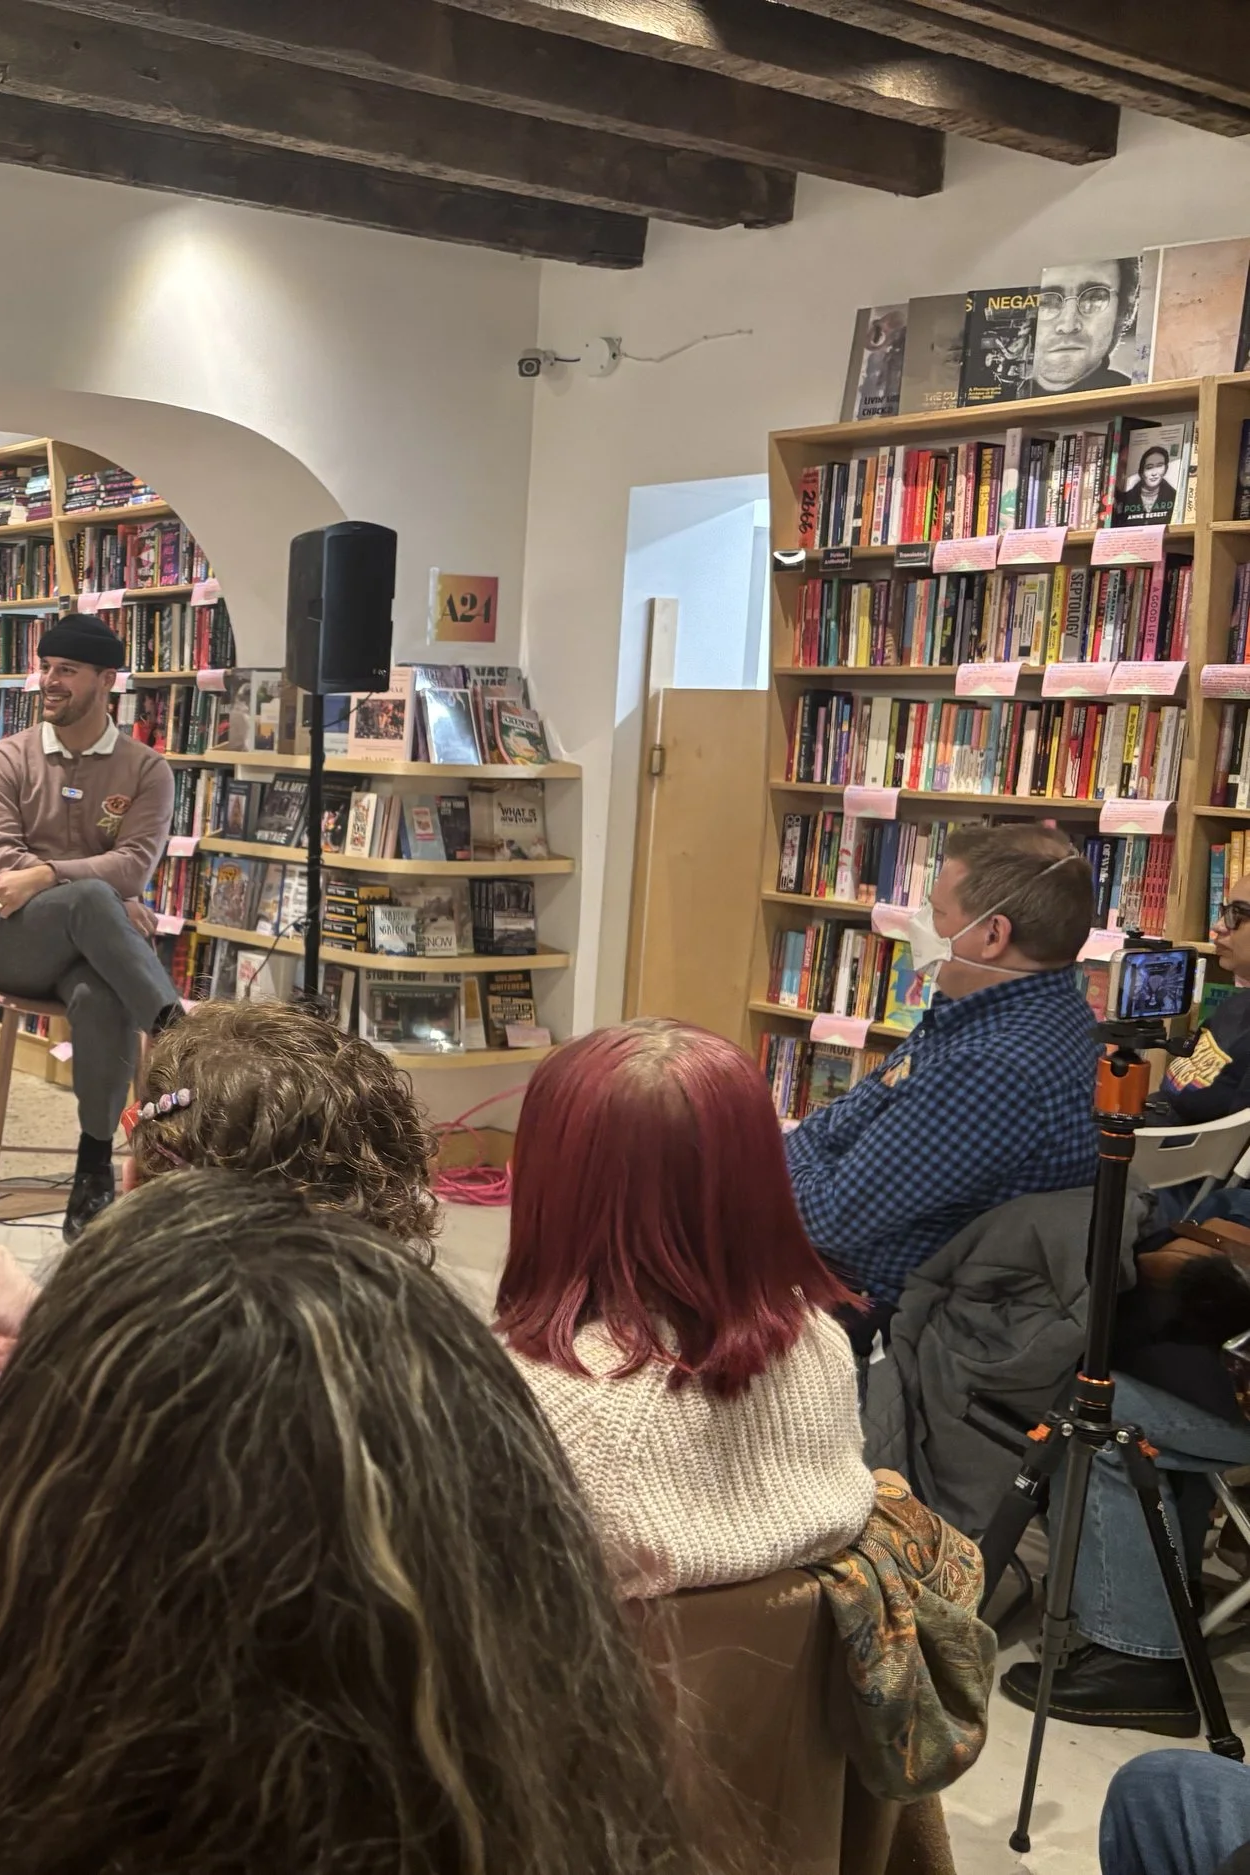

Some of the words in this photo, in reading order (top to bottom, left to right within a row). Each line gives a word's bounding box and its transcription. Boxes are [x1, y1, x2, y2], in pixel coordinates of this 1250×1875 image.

[799, 490, 817, 534] 2666
[1065, 573, 1085, 639] SEPTOLOGY
[1149, 594, 1160, 623] GOOD
[1146, 625, 1157, 643] LIFE
[501, 807, 527, 817] WHAT
[528, 808, 536, 817] IS
